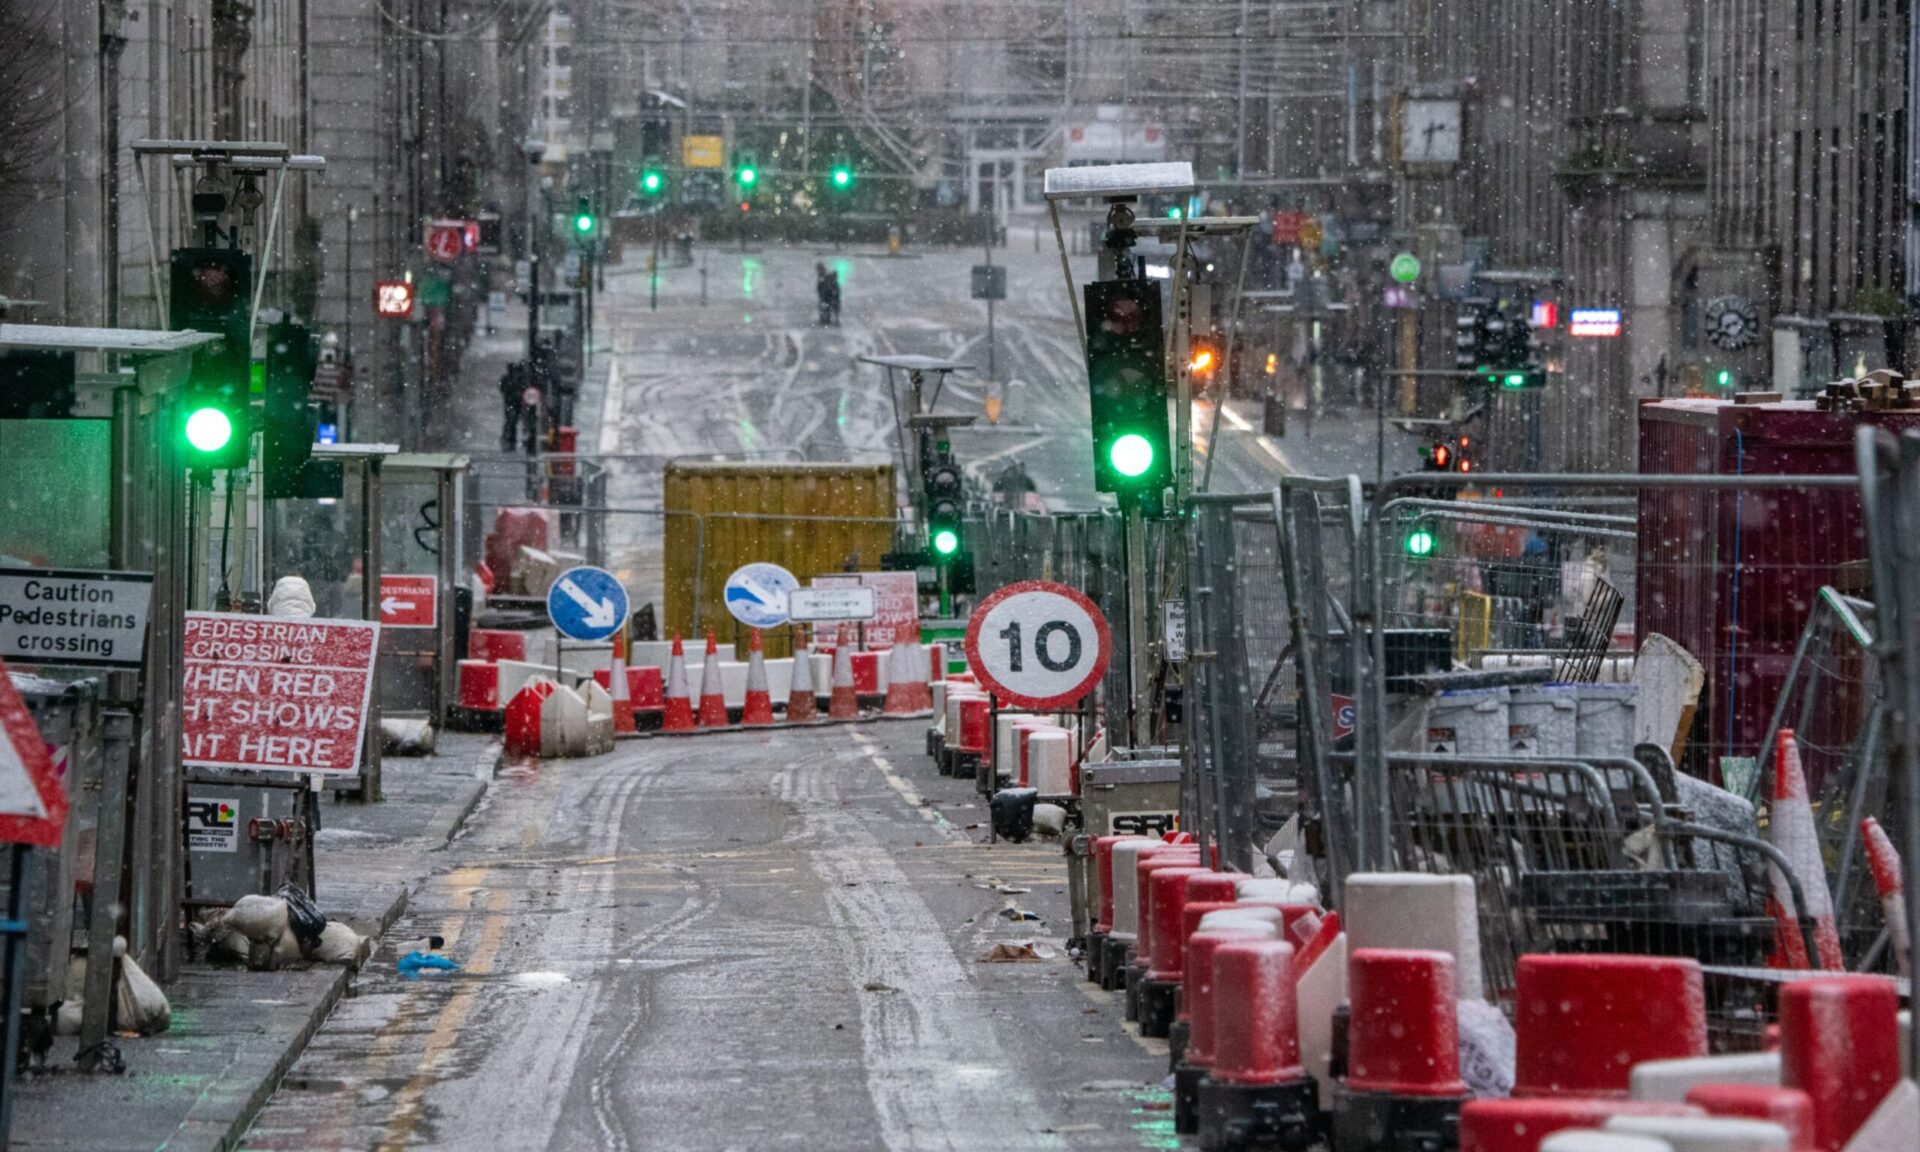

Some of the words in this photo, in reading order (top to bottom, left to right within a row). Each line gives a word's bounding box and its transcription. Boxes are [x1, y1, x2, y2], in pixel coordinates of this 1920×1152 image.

[24, 580, 114, 603] Caution
[0, 604, 136, 630] Pedestrians
[185, 619, 328, 643] PEDESTRIAN
[18, 633, 114, 657] crossing
[192, 640, 314, 663] CROSSING
[1000, 620, 1082, 673] 10
[183, 666, 260, 693] HEN
[271, 671, 337, 697] RED
[230, 699, 356, 730] SHOWS
[238, 734, 336, 767] HERE
